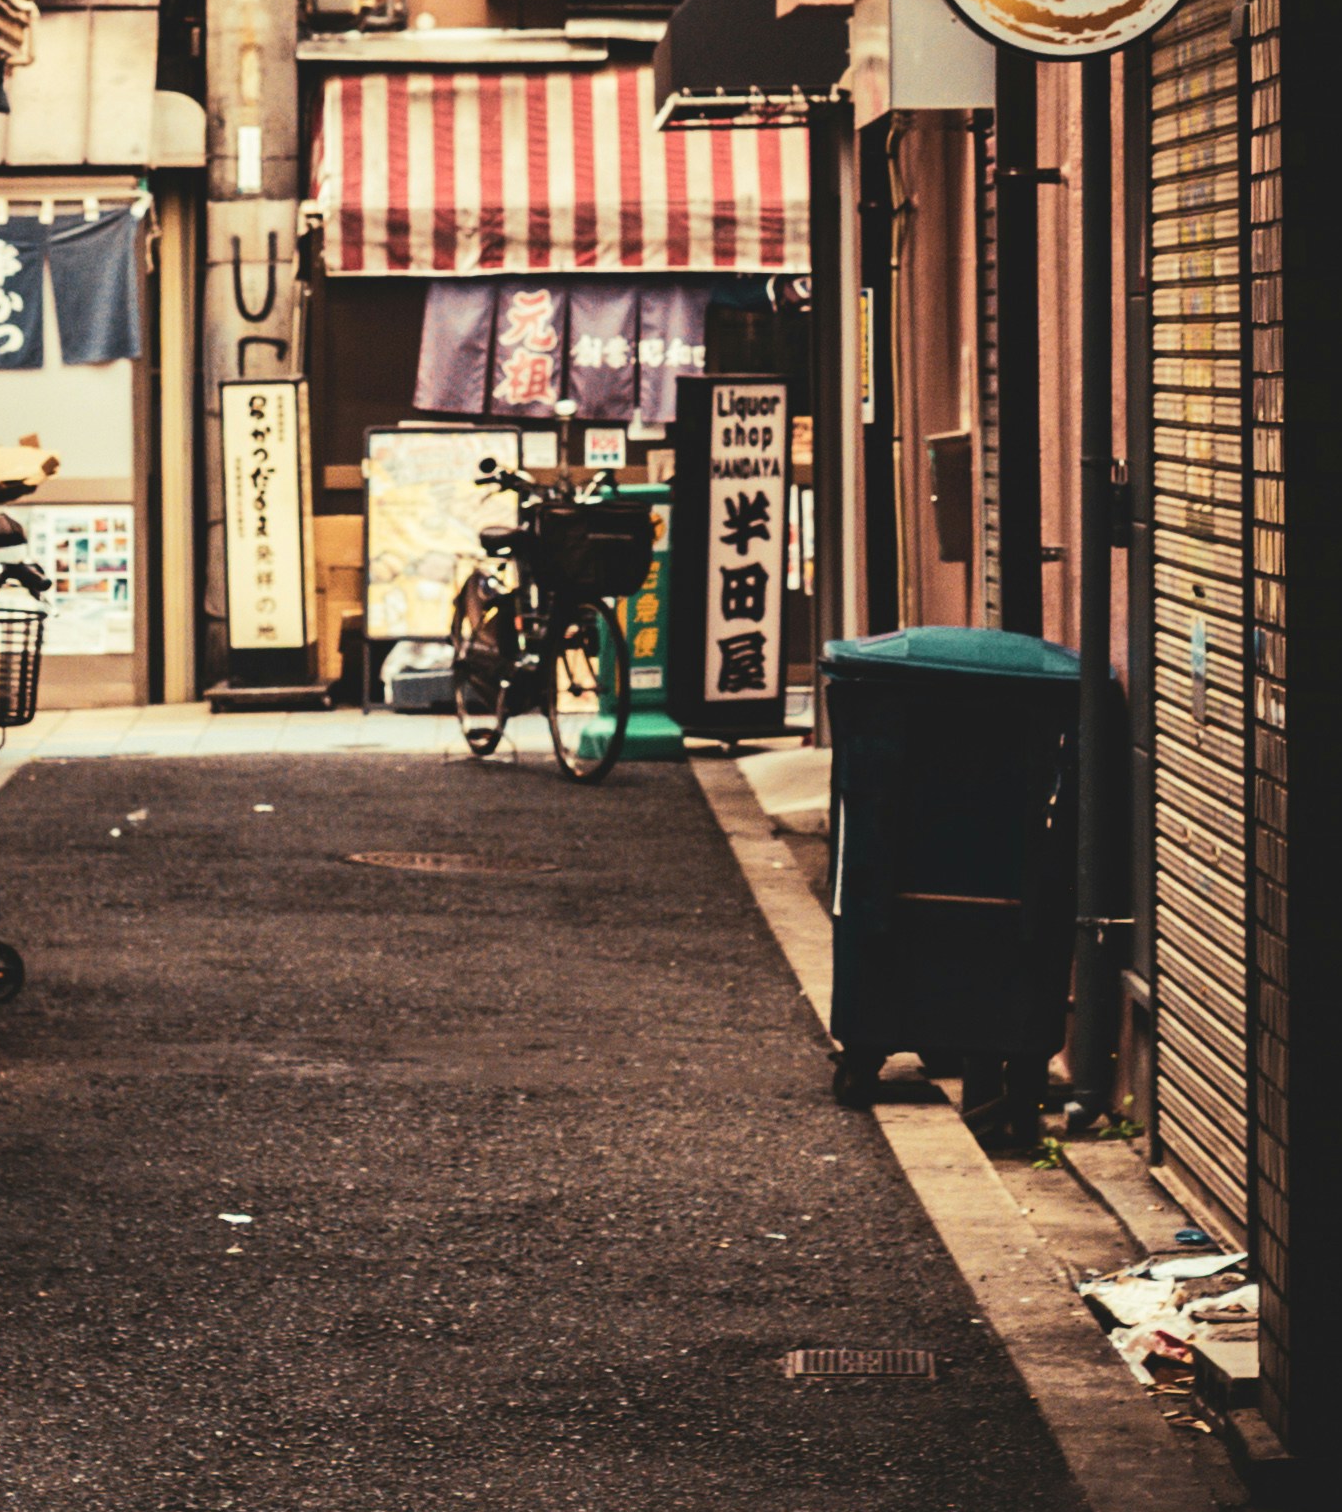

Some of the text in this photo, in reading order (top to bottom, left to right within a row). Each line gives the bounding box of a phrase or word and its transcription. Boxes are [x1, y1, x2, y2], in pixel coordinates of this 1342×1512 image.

[492, 288, 558, 405] 元祖
[717, 389, 781, 422] Liquor
[722, 422, 774, 452] shop
[719, 489, 771, 693] 半田屋
